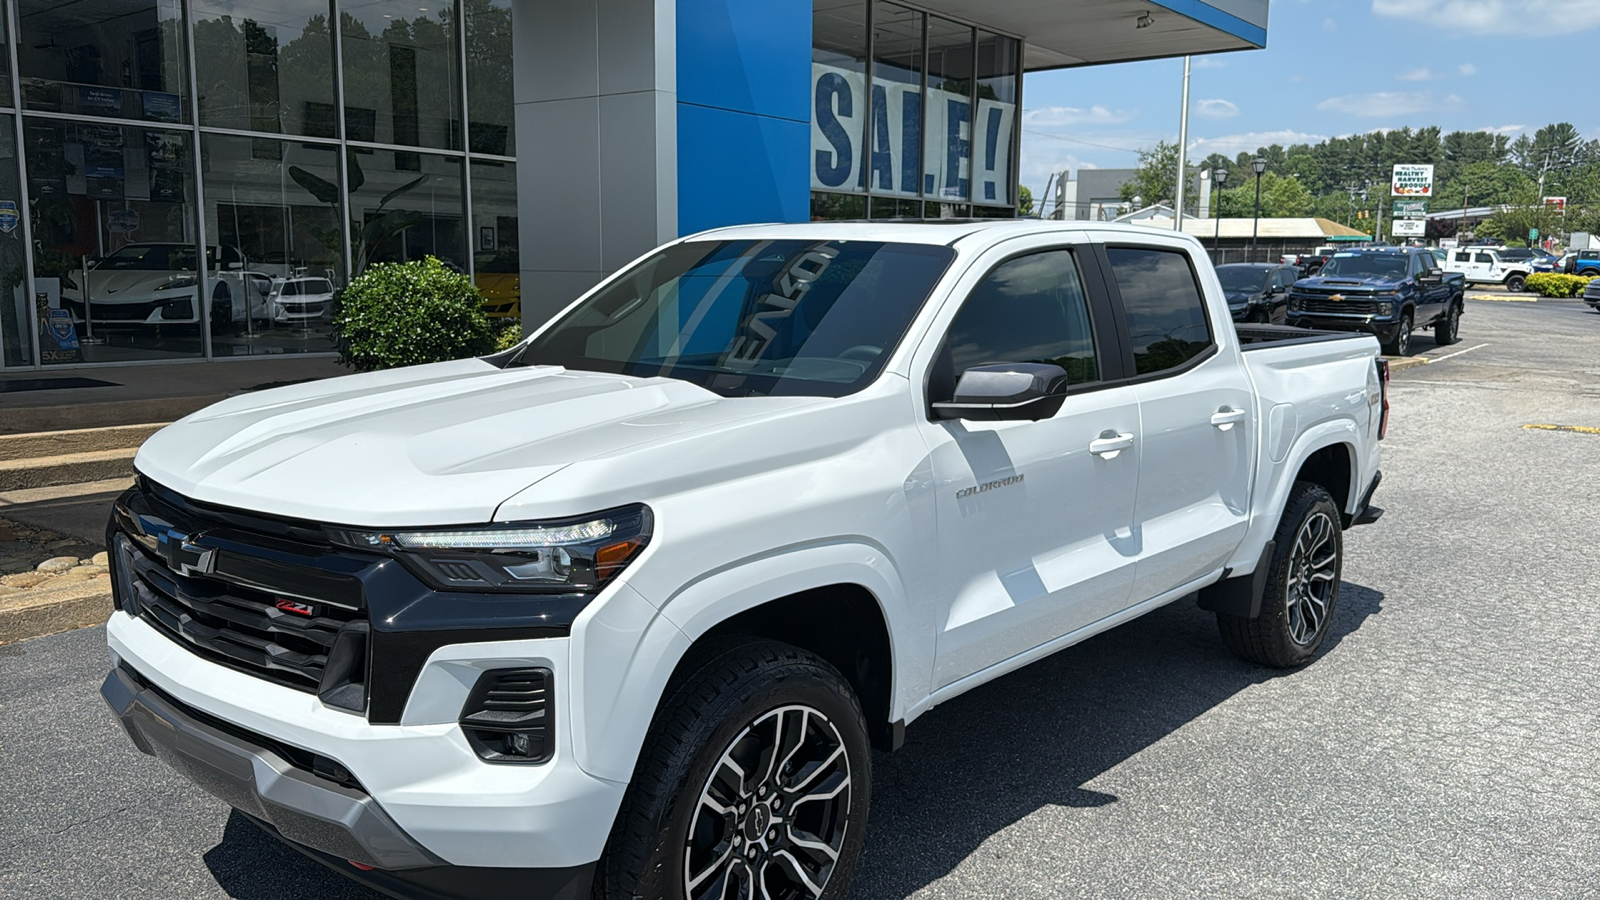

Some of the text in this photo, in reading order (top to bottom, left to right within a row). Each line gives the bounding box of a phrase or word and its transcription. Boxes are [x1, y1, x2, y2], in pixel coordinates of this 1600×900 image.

[815, 72, 1004, 200] SALE!
[955, 473, 1024, 499] COLORADO
[276, 598, 314, 616] Z71
